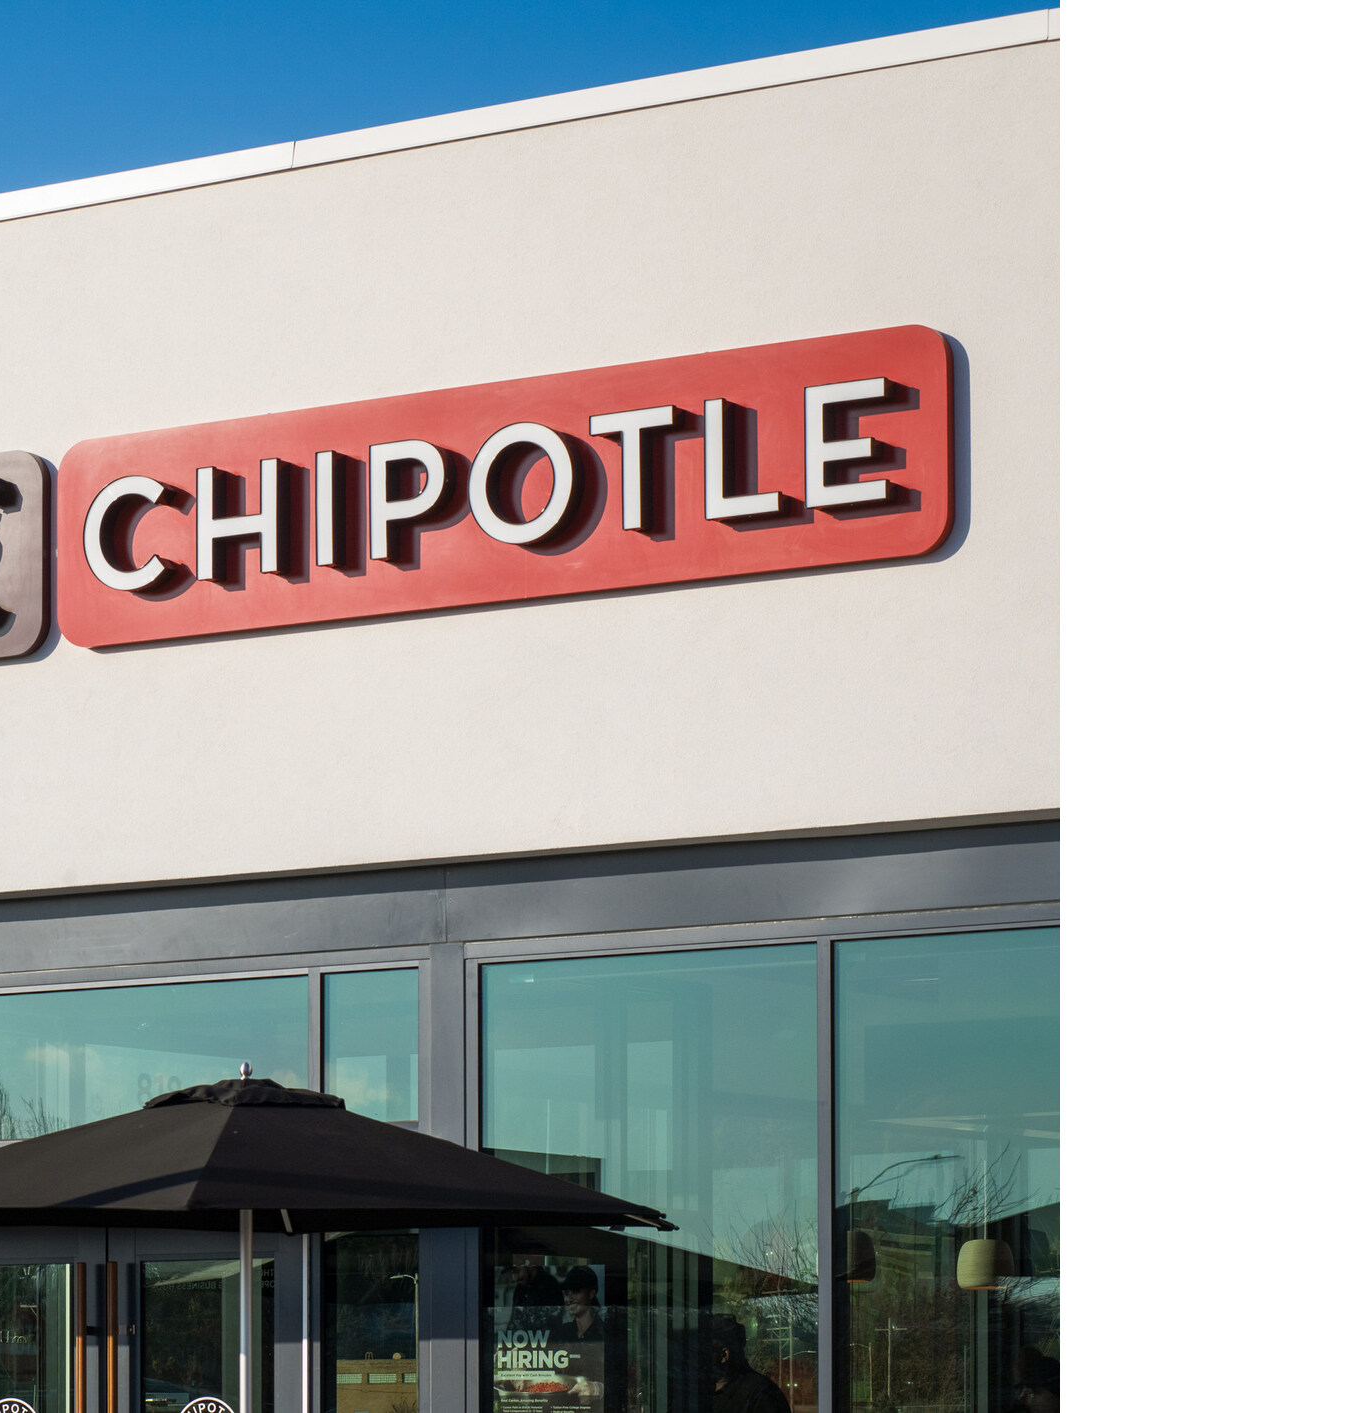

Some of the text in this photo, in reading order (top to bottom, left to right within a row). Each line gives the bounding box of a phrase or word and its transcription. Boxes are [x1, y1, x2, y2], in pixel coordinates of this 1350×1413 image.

[82, 376, 890, 592] CHIPOTLE
[497, 1329, 550, 1349] NOW
[497, 1349, 569, 1369] HIRING
[186, 1402, 226, 1413] IPOT
